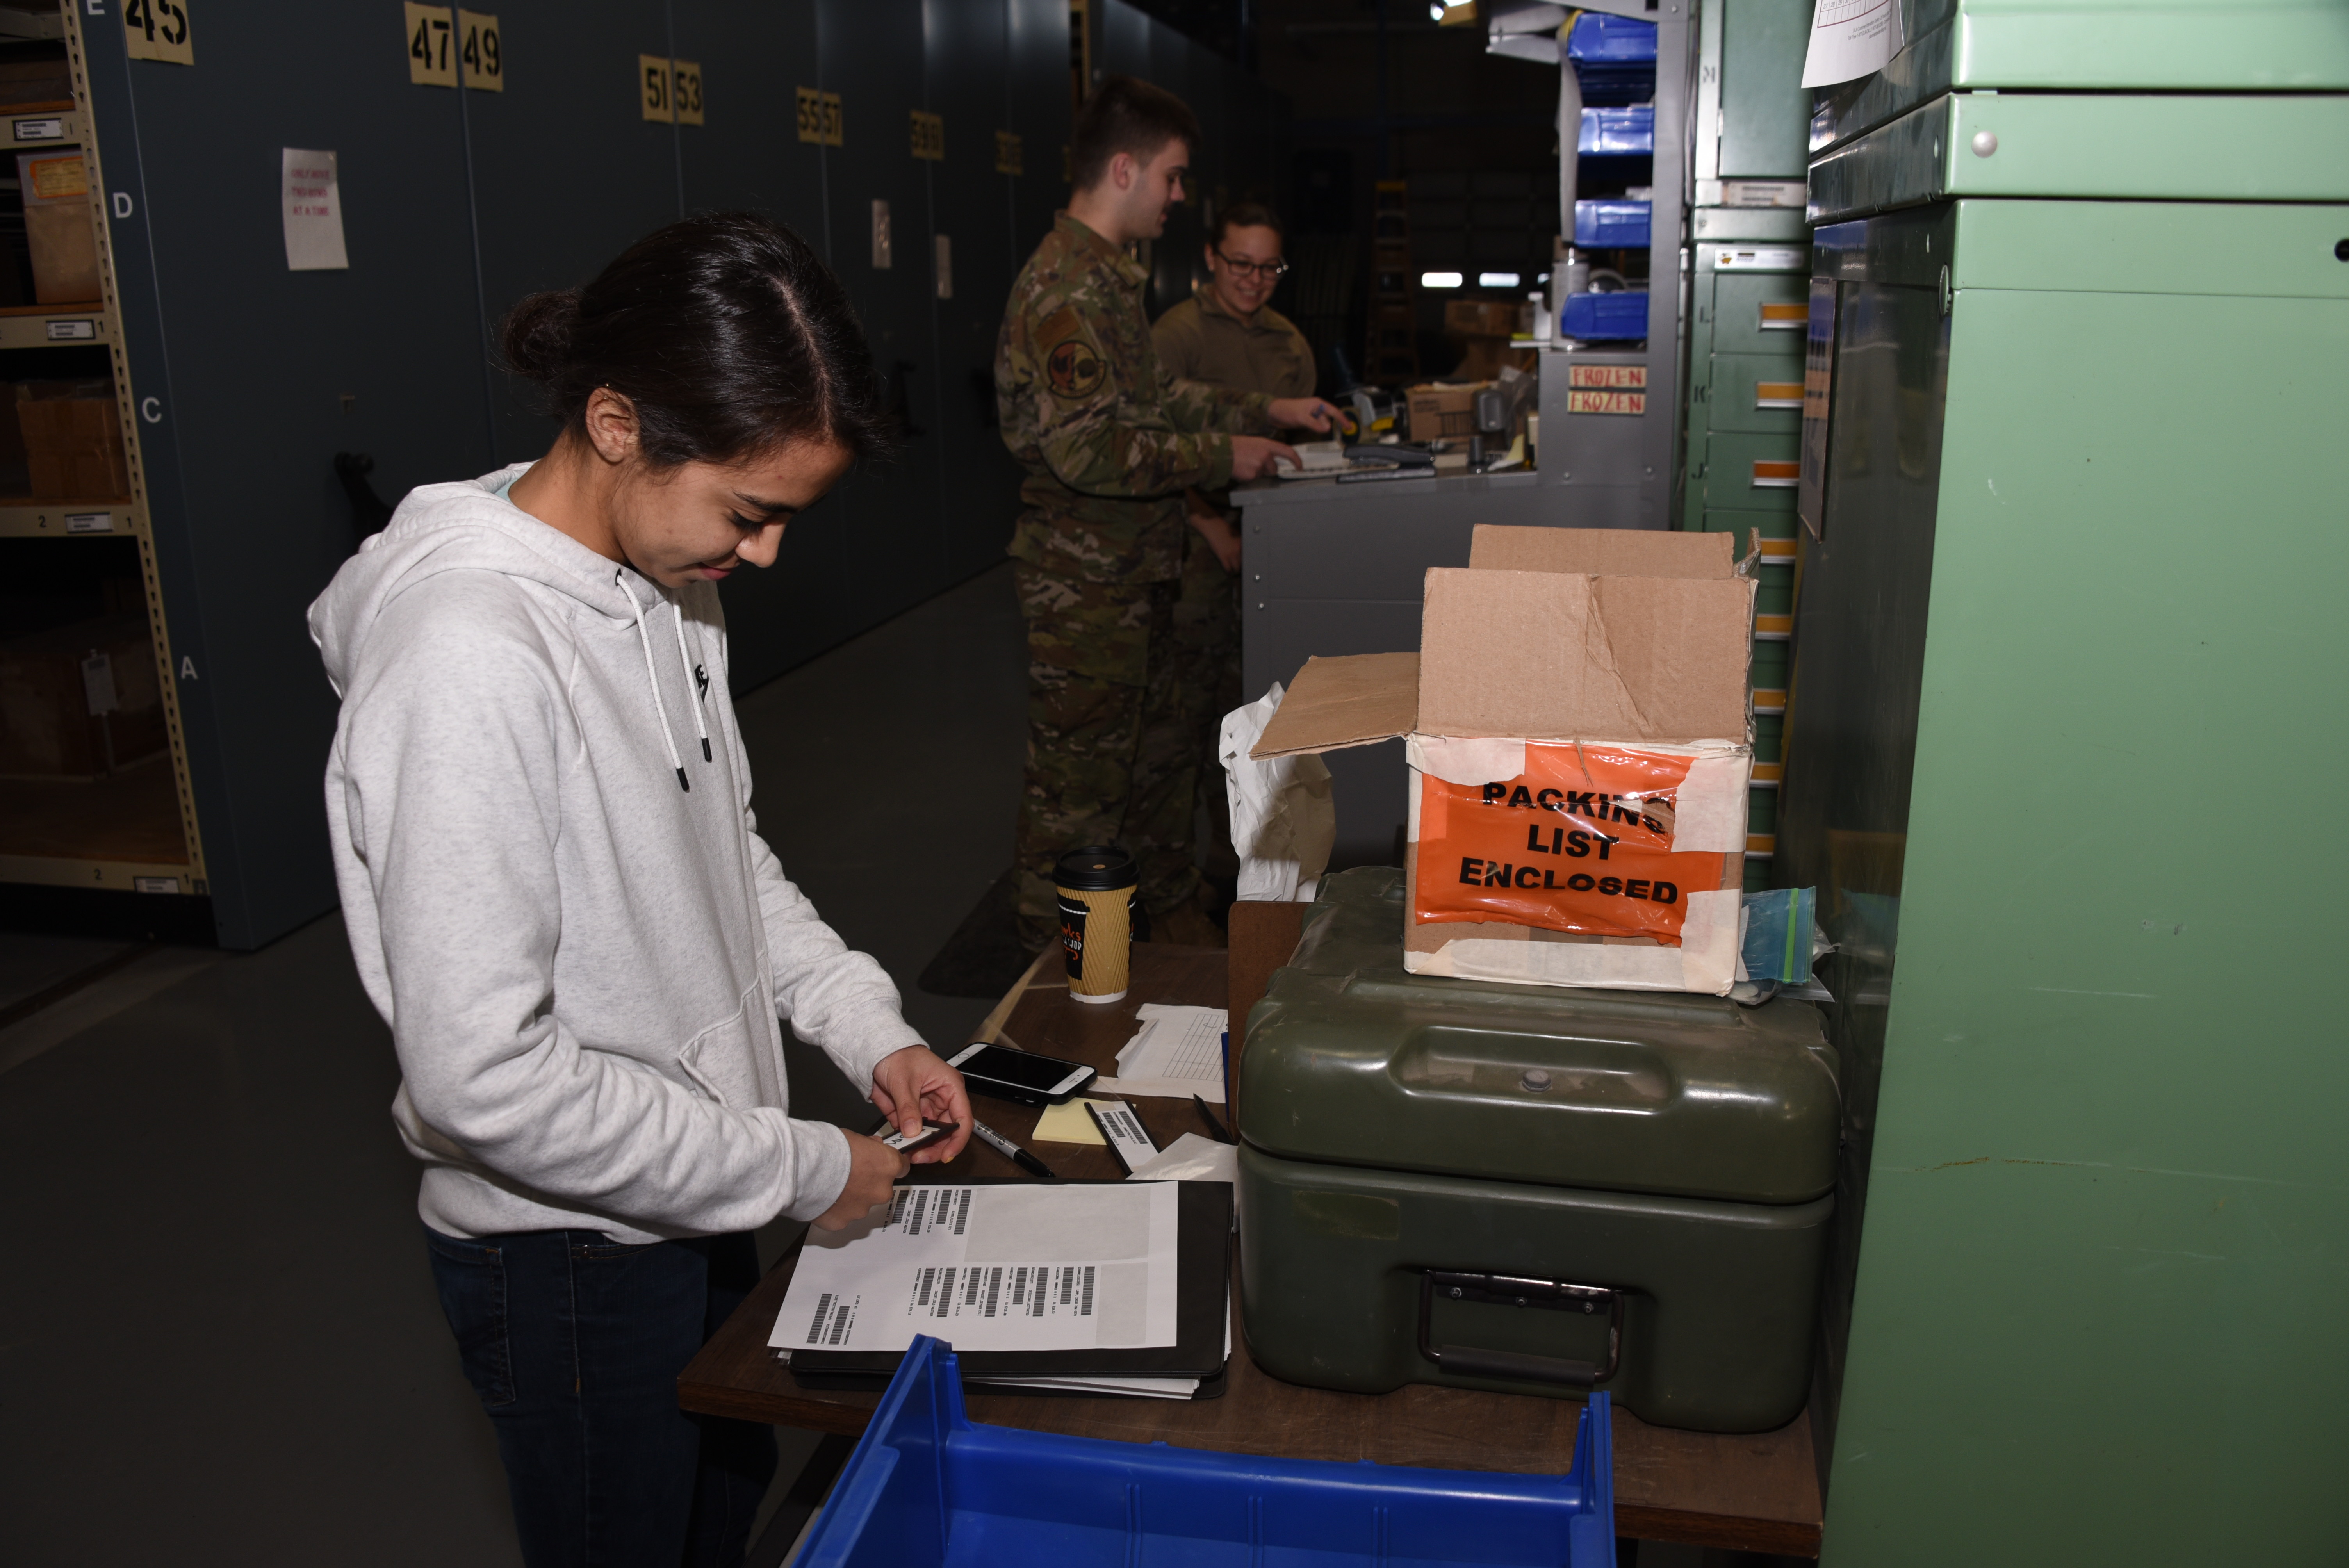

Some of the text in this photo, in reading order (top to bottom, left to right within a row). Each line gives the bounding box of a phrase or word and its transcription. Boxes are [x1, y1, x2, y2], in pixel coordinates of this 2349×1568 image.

[126, 0, 187, 45] 45
[411, 18, 449, 71] 47
[463, 26, 500, 76] 49
[647, 68, 668, 111] 51
[676, 72, 702, 112] 53
[798, 97, 819, 133] 55
[823, 102, 840, 137] 57
[113, 193, 133, 218] D
[1574, 369, 1641, 387] FROZEN
[1571, 392, 1641, 413] FROZEN
[1694, 385, 1706, 403] K
[142, 397, 162, 424] C
[1691, 463, 1704, 479] J
[39, 516, 46, 527] 2
[127, 517, 132, 527] 1
[180, 656, 198, 680] A
[1527, 824, 1619, 860] LIST
[94, 868, 102, 880] 2
[1459, 857, 1678, 904] ENCLOSED
